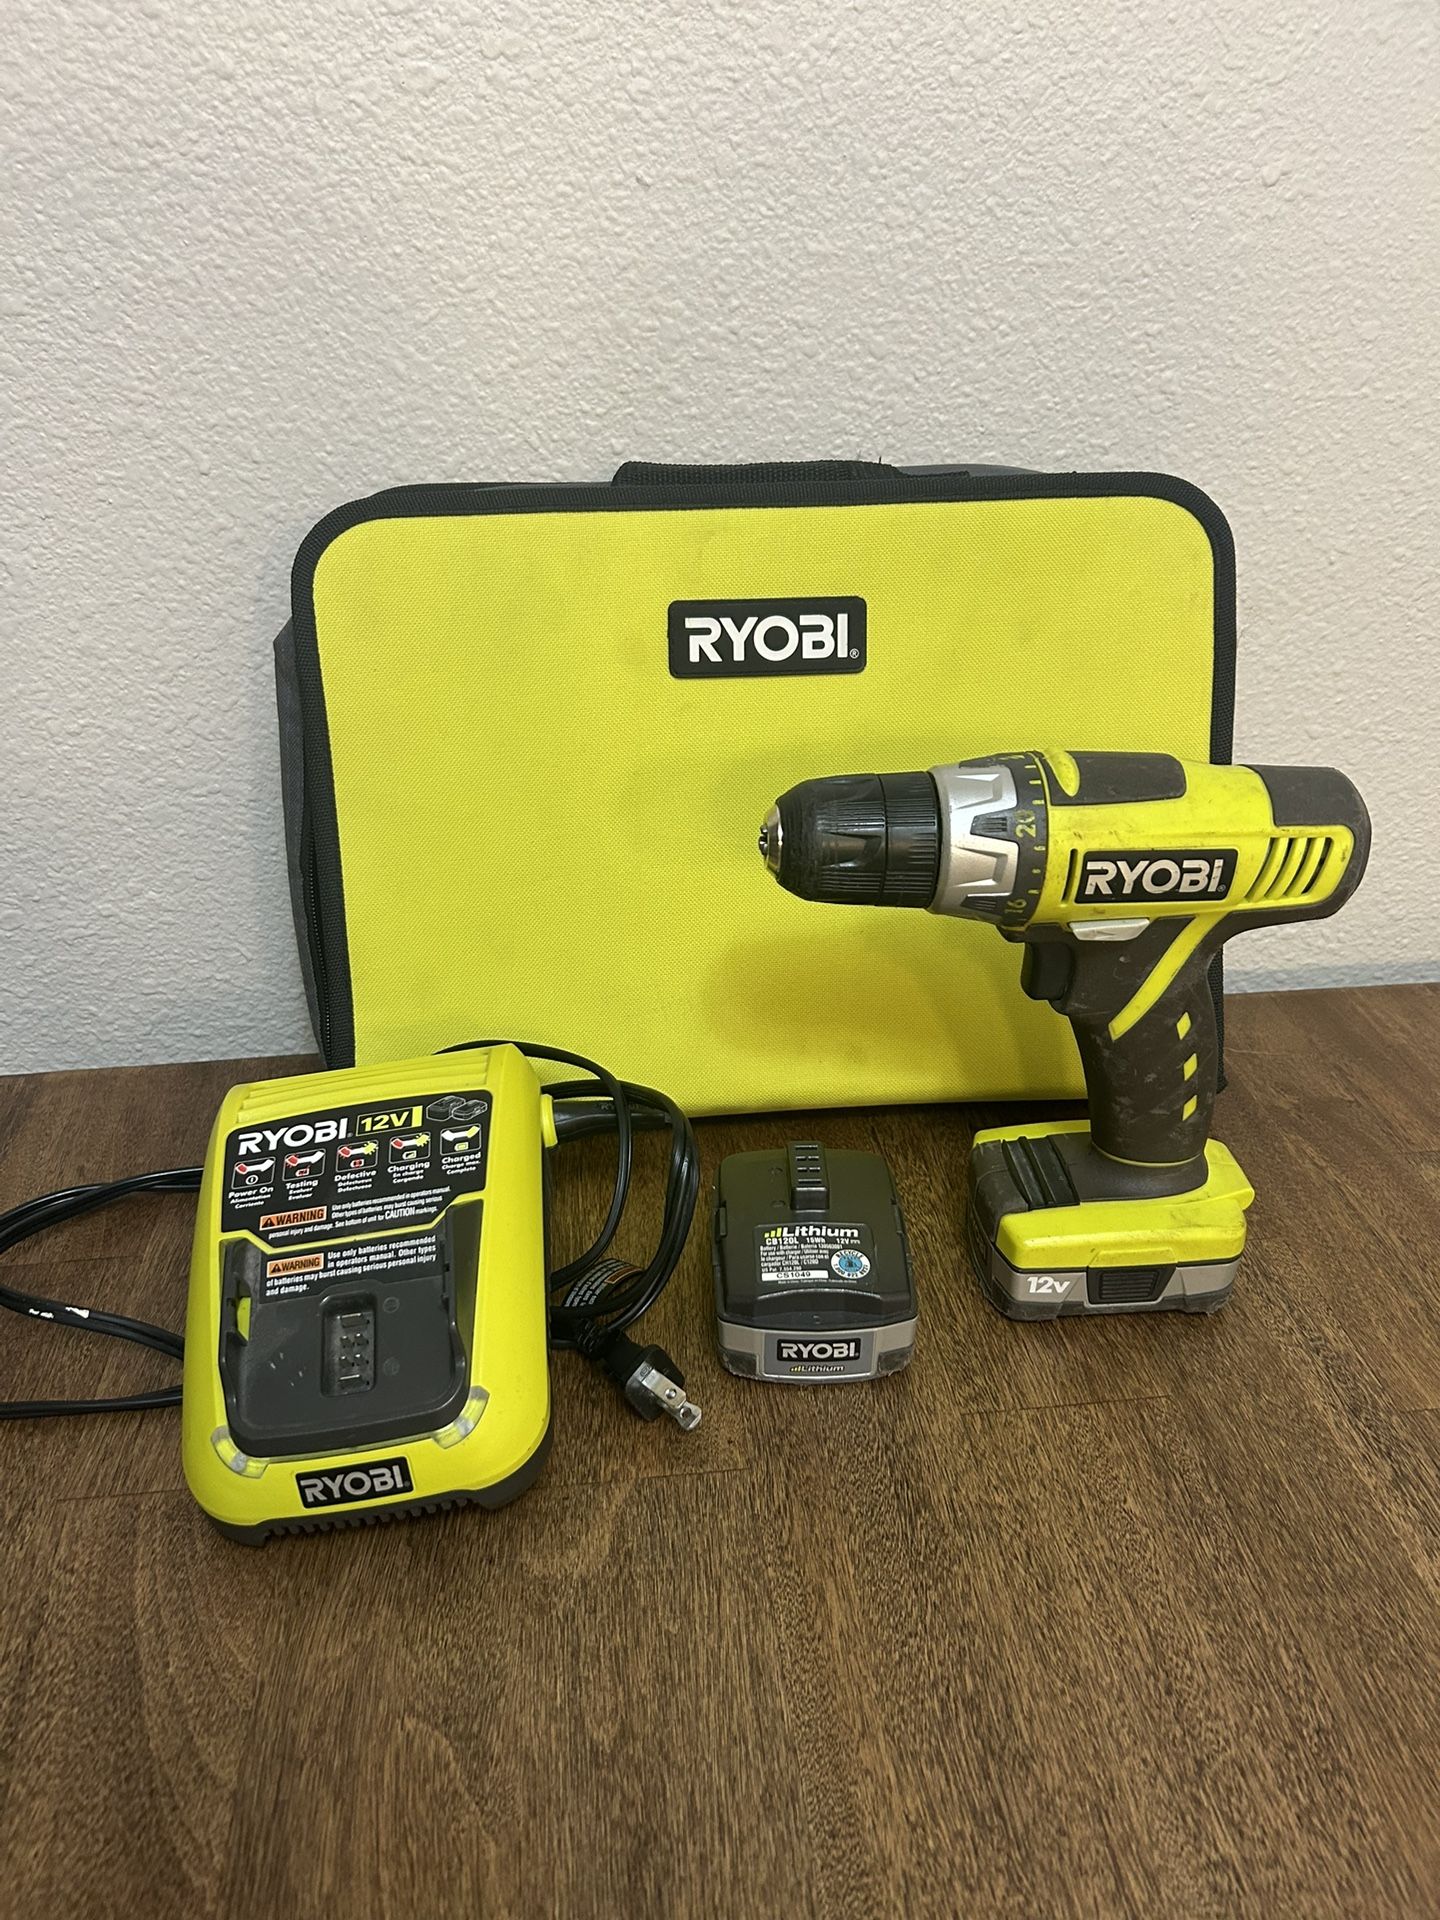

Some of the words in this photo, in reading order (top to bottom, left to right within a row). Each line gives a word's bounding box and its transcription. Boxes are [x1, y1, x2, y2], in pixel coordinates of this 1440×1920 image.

[685, 613, 848, 662] RYOBI
[1085, 859, 1224, 894] RYOBI
[238, 1118, 348, 1155] RYOBI
[361, 1111, 409, 1132] 12V
[442, 1152, 482, 1164] Charged
[387, 1161, 431, 1173] Charging
[334, 1170, 377, 1182] Defective
[228, 1190, 257, 1199] Power
[259, 1186, 274, 1194] On
[286, 1180, 319, 1190] Testing
[276, 1208, 325, 1226] WARNING
[385, 1206, 415, 1220] CAUTION
[782, 1226, 859, 1237] Lithium
[327, 1251, 341, 1260] Use
[342, 1248, 356, 1258] only
[358, 1243, 388, 1255] batteries
[388, 1235, 436, 1250] recommended
[335, 1256, 368, 1268] operators
[368, 1250, 397, 1261] manual.
[398, 1247, 417, 1257] Other
[418, 1244, 436, 1255] types
[266, 1279, 274, 1287] of
[274, 1274, 304, 1285] batteries
[304, 1271, 318, 1282] may
[319, 1269, 336, 1279] burst
[336, 1265, 362, 1275] causing
[362, 1260, 387, 1272] serious
[387, 1255, 417, 1269] personal
[417, 1253, 436, 1264] injury
[281, 1257, 320, 1273] WARNING
[265, 1287, 279, 1296] and
[280, 1283, 310, 1295] damage.
[781, 1342, 855, 1359] RYOBI
[300, 1465, 403, 1502] RYOBI
